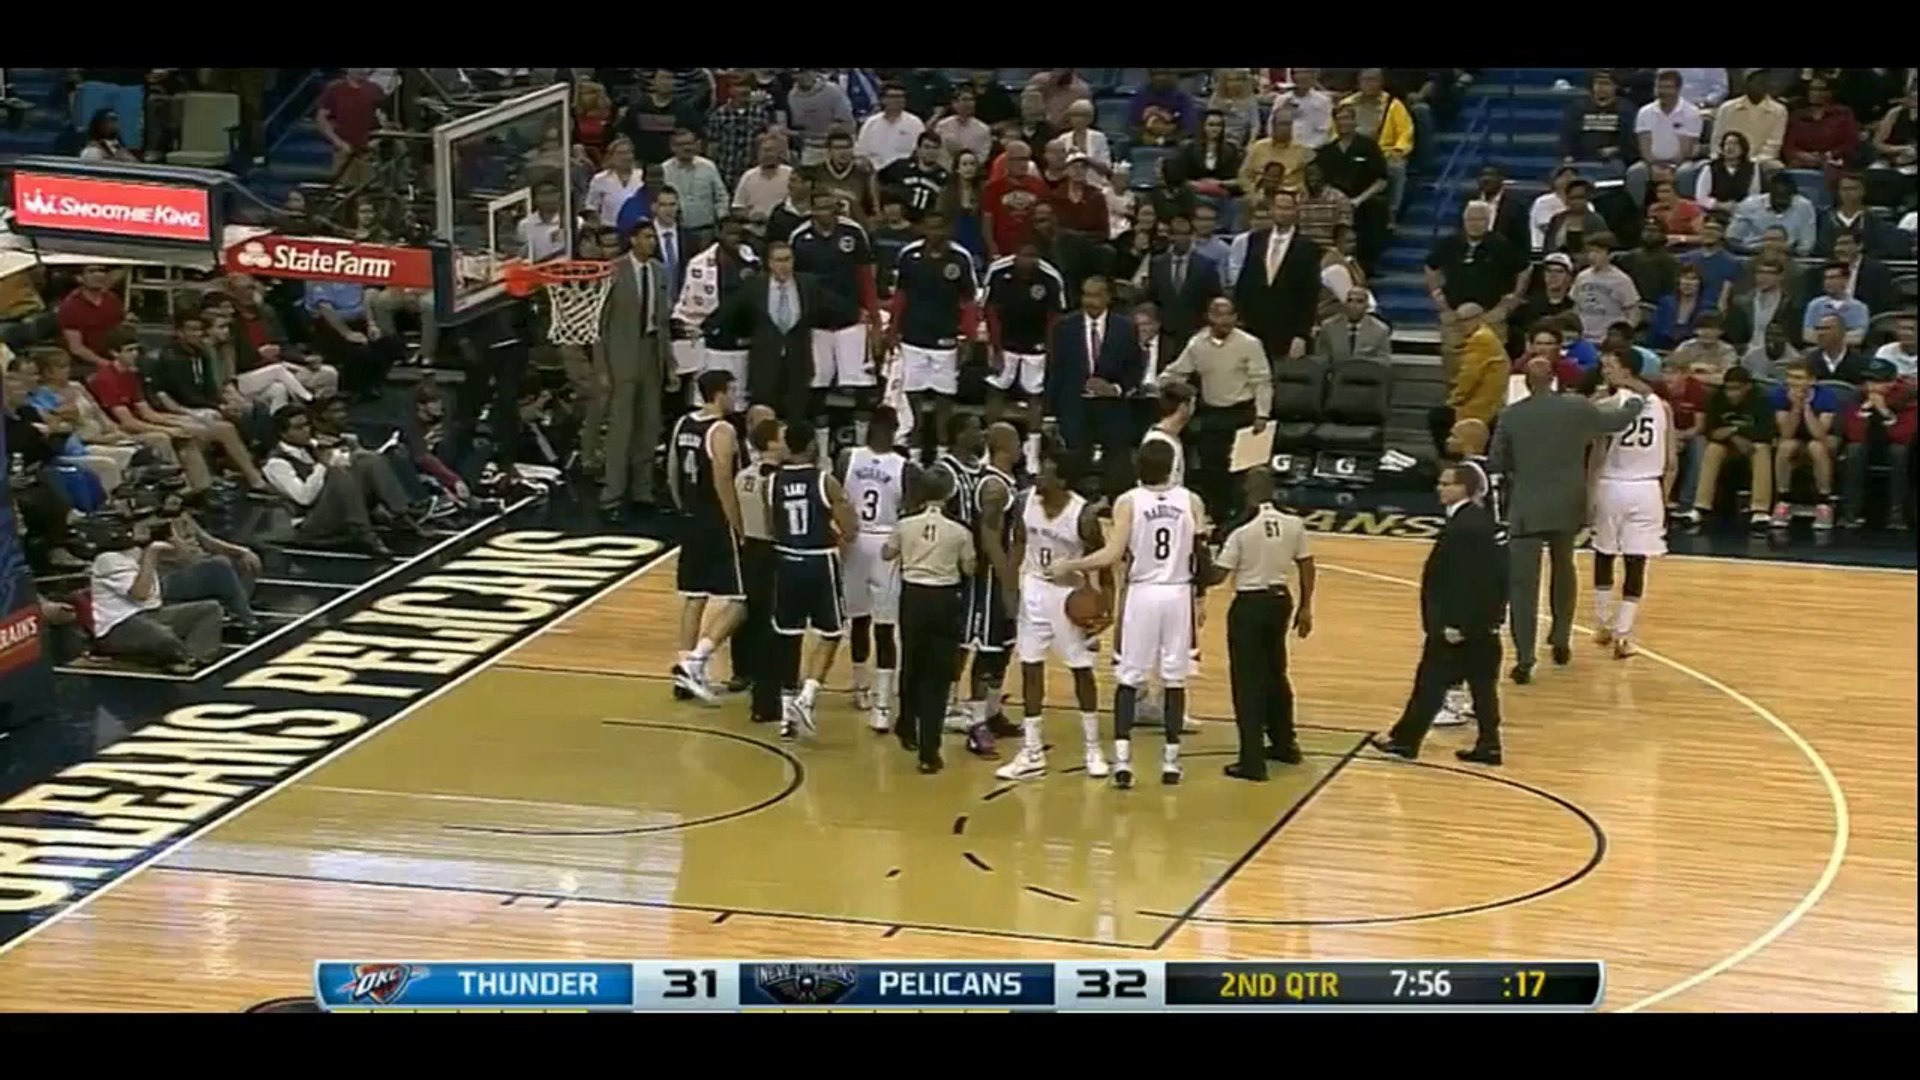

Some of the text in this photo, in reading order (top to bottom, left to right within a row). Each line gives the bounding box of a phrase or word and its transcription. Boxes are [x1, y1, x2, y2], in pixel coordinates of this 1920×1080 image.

[59, 196, 202, 229] SMOOTHIE KING
[1619, 417, 1655, 447] 25
[683, 448, 698, 484] 4
[1272, 454, 1292, 472] G
[1335, 457, 1356, 474] G
[861, 488, 880, 522] 3
[921, 523, 937, 543] 41
[1154, 526, 1171, 562] 8
[225, 530, 666, 700] PELICANS
